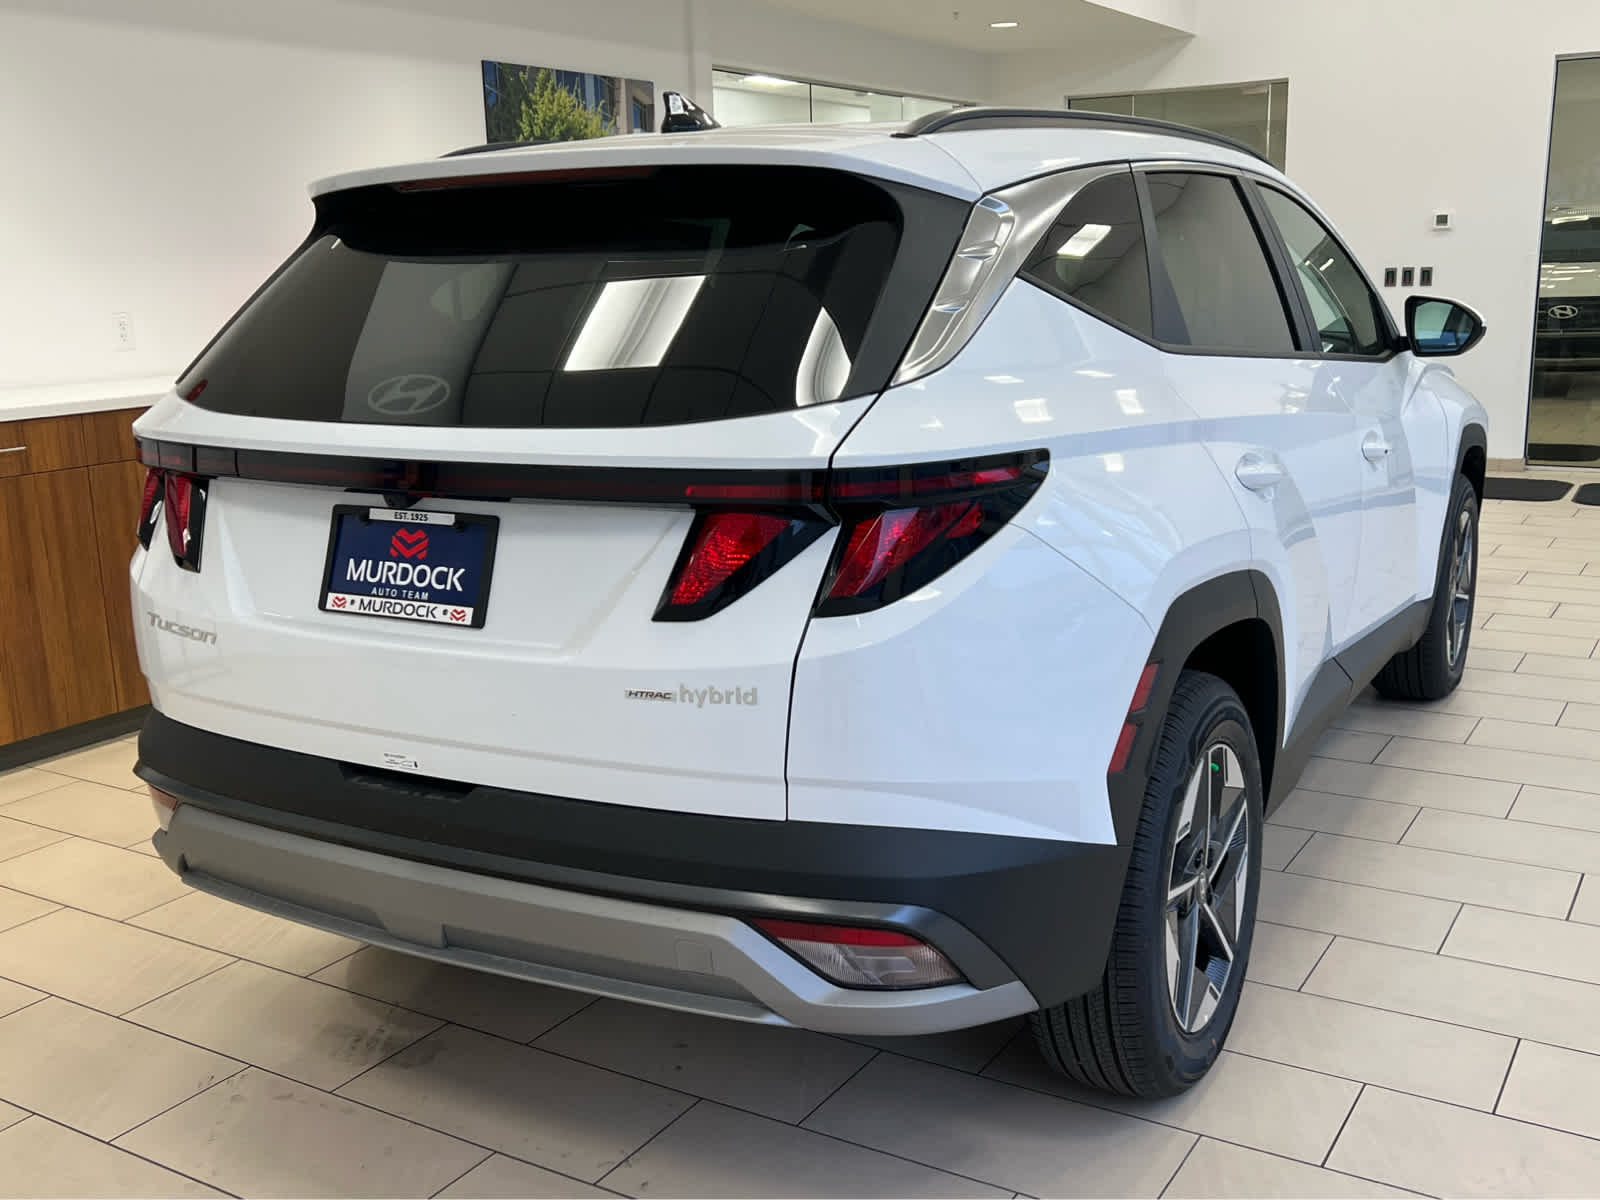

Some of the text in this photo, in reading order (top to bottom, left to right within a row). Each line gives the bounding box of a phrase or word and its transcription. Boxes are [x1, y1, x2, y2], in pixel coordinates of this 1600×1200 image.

[394, 511, 429, 522] EST. 1925
[346, 558, 466, 592] MURDOCK
[371, 586, 429, 601] AUTO TEAM
[358, 598, 438, 619] MURDOCK
[628, 682, 758, 709] HTRAC hybrid
